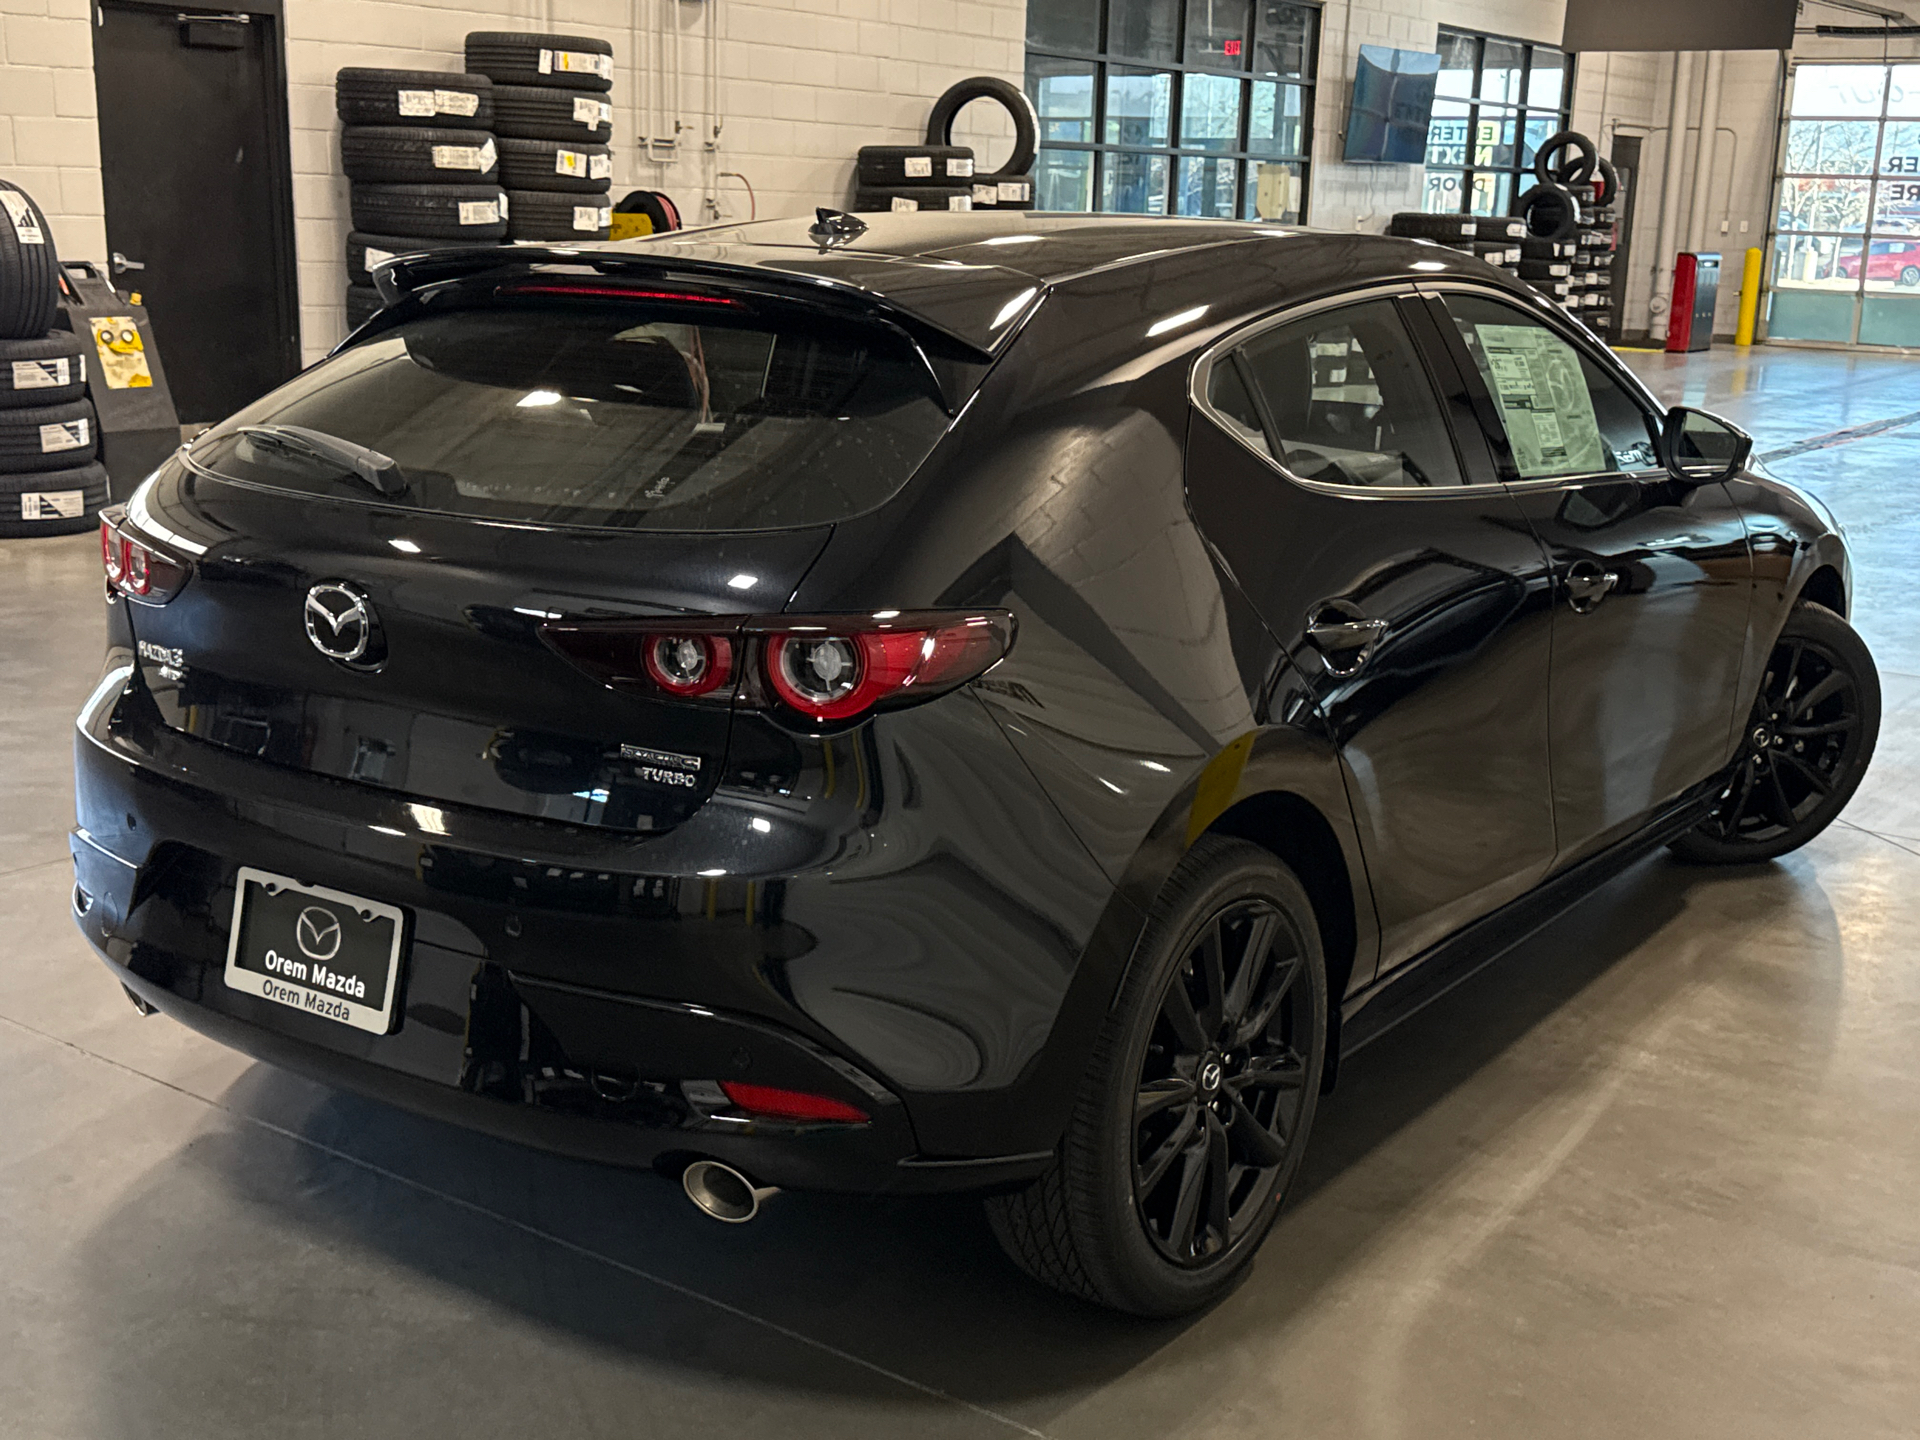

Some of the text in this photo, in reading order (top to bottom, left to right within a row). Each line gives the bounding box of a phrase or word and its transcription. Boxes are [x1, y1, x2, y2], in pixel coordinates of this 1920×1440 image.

[642, 766, 696, 787] TURBO
[265, 950, 365, 998] Orem Mazda
[262, 979, 350, 1021] Orem Mazda
